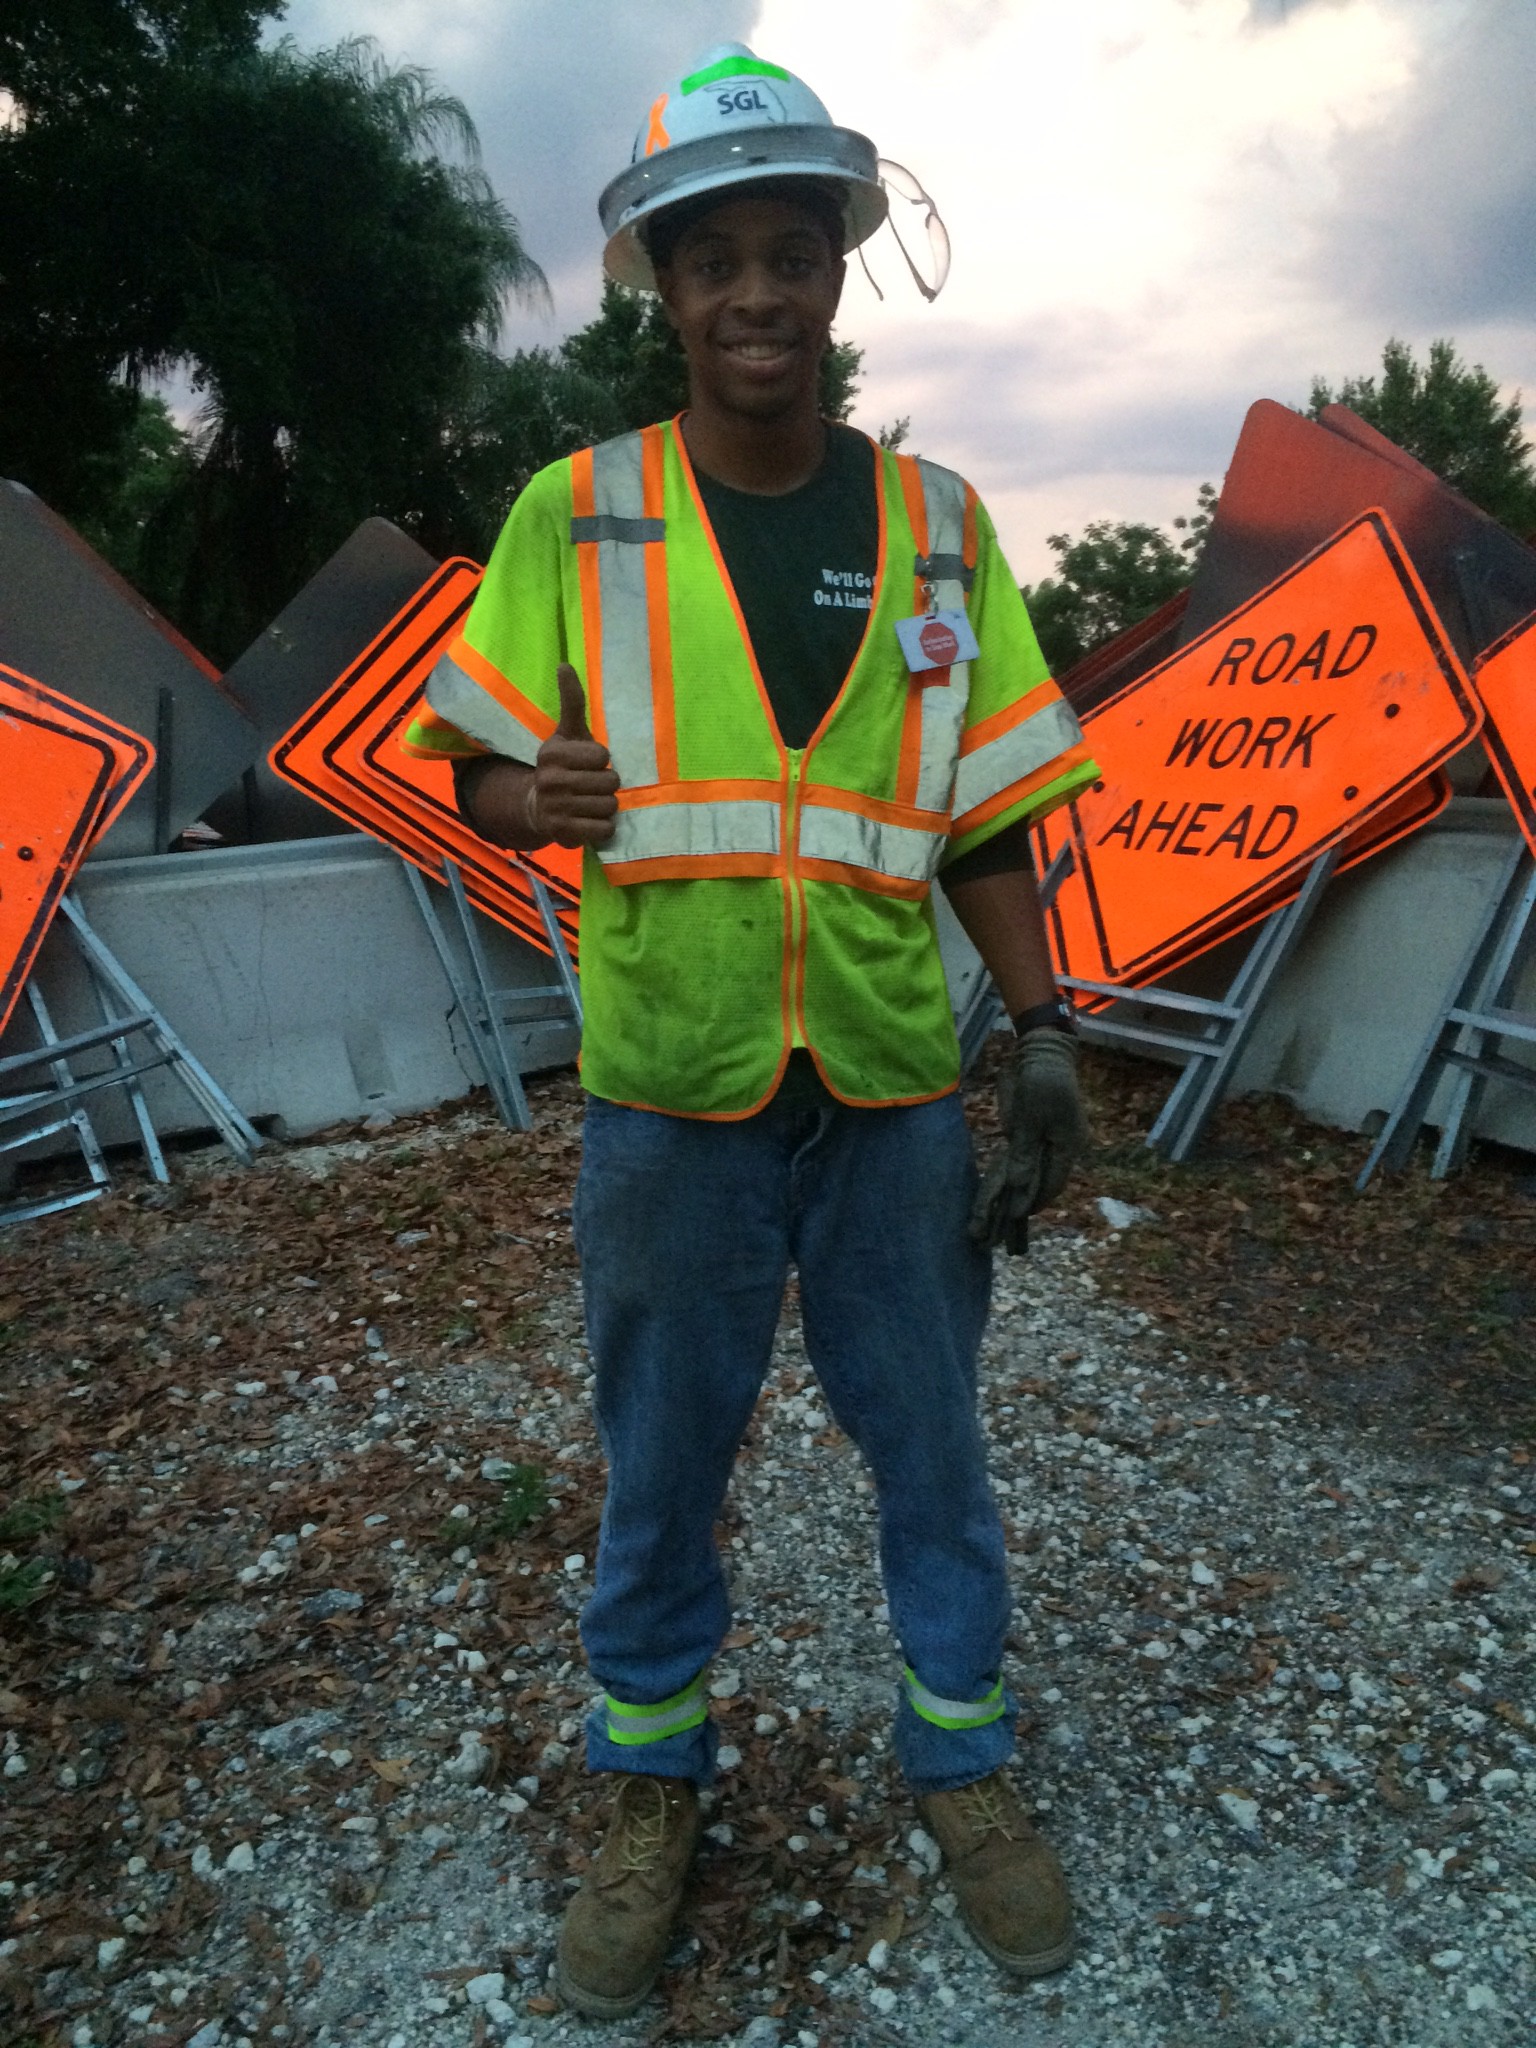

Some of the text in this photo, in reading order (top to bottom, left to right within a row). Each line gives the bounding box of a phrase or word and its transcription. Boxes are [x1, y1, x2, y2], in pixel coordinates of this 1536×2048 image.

[717, 90, 767, 115] SGL
[814, 590, 831, 605] On
[833, 591, 843, 606] A
[822, 569, 853, 587] We'll
[1208, 625, 1377, 686] ROAD
[1165, 713, 1337, 769] WORK
[1096, 799, 1299, 859] AHEAD
